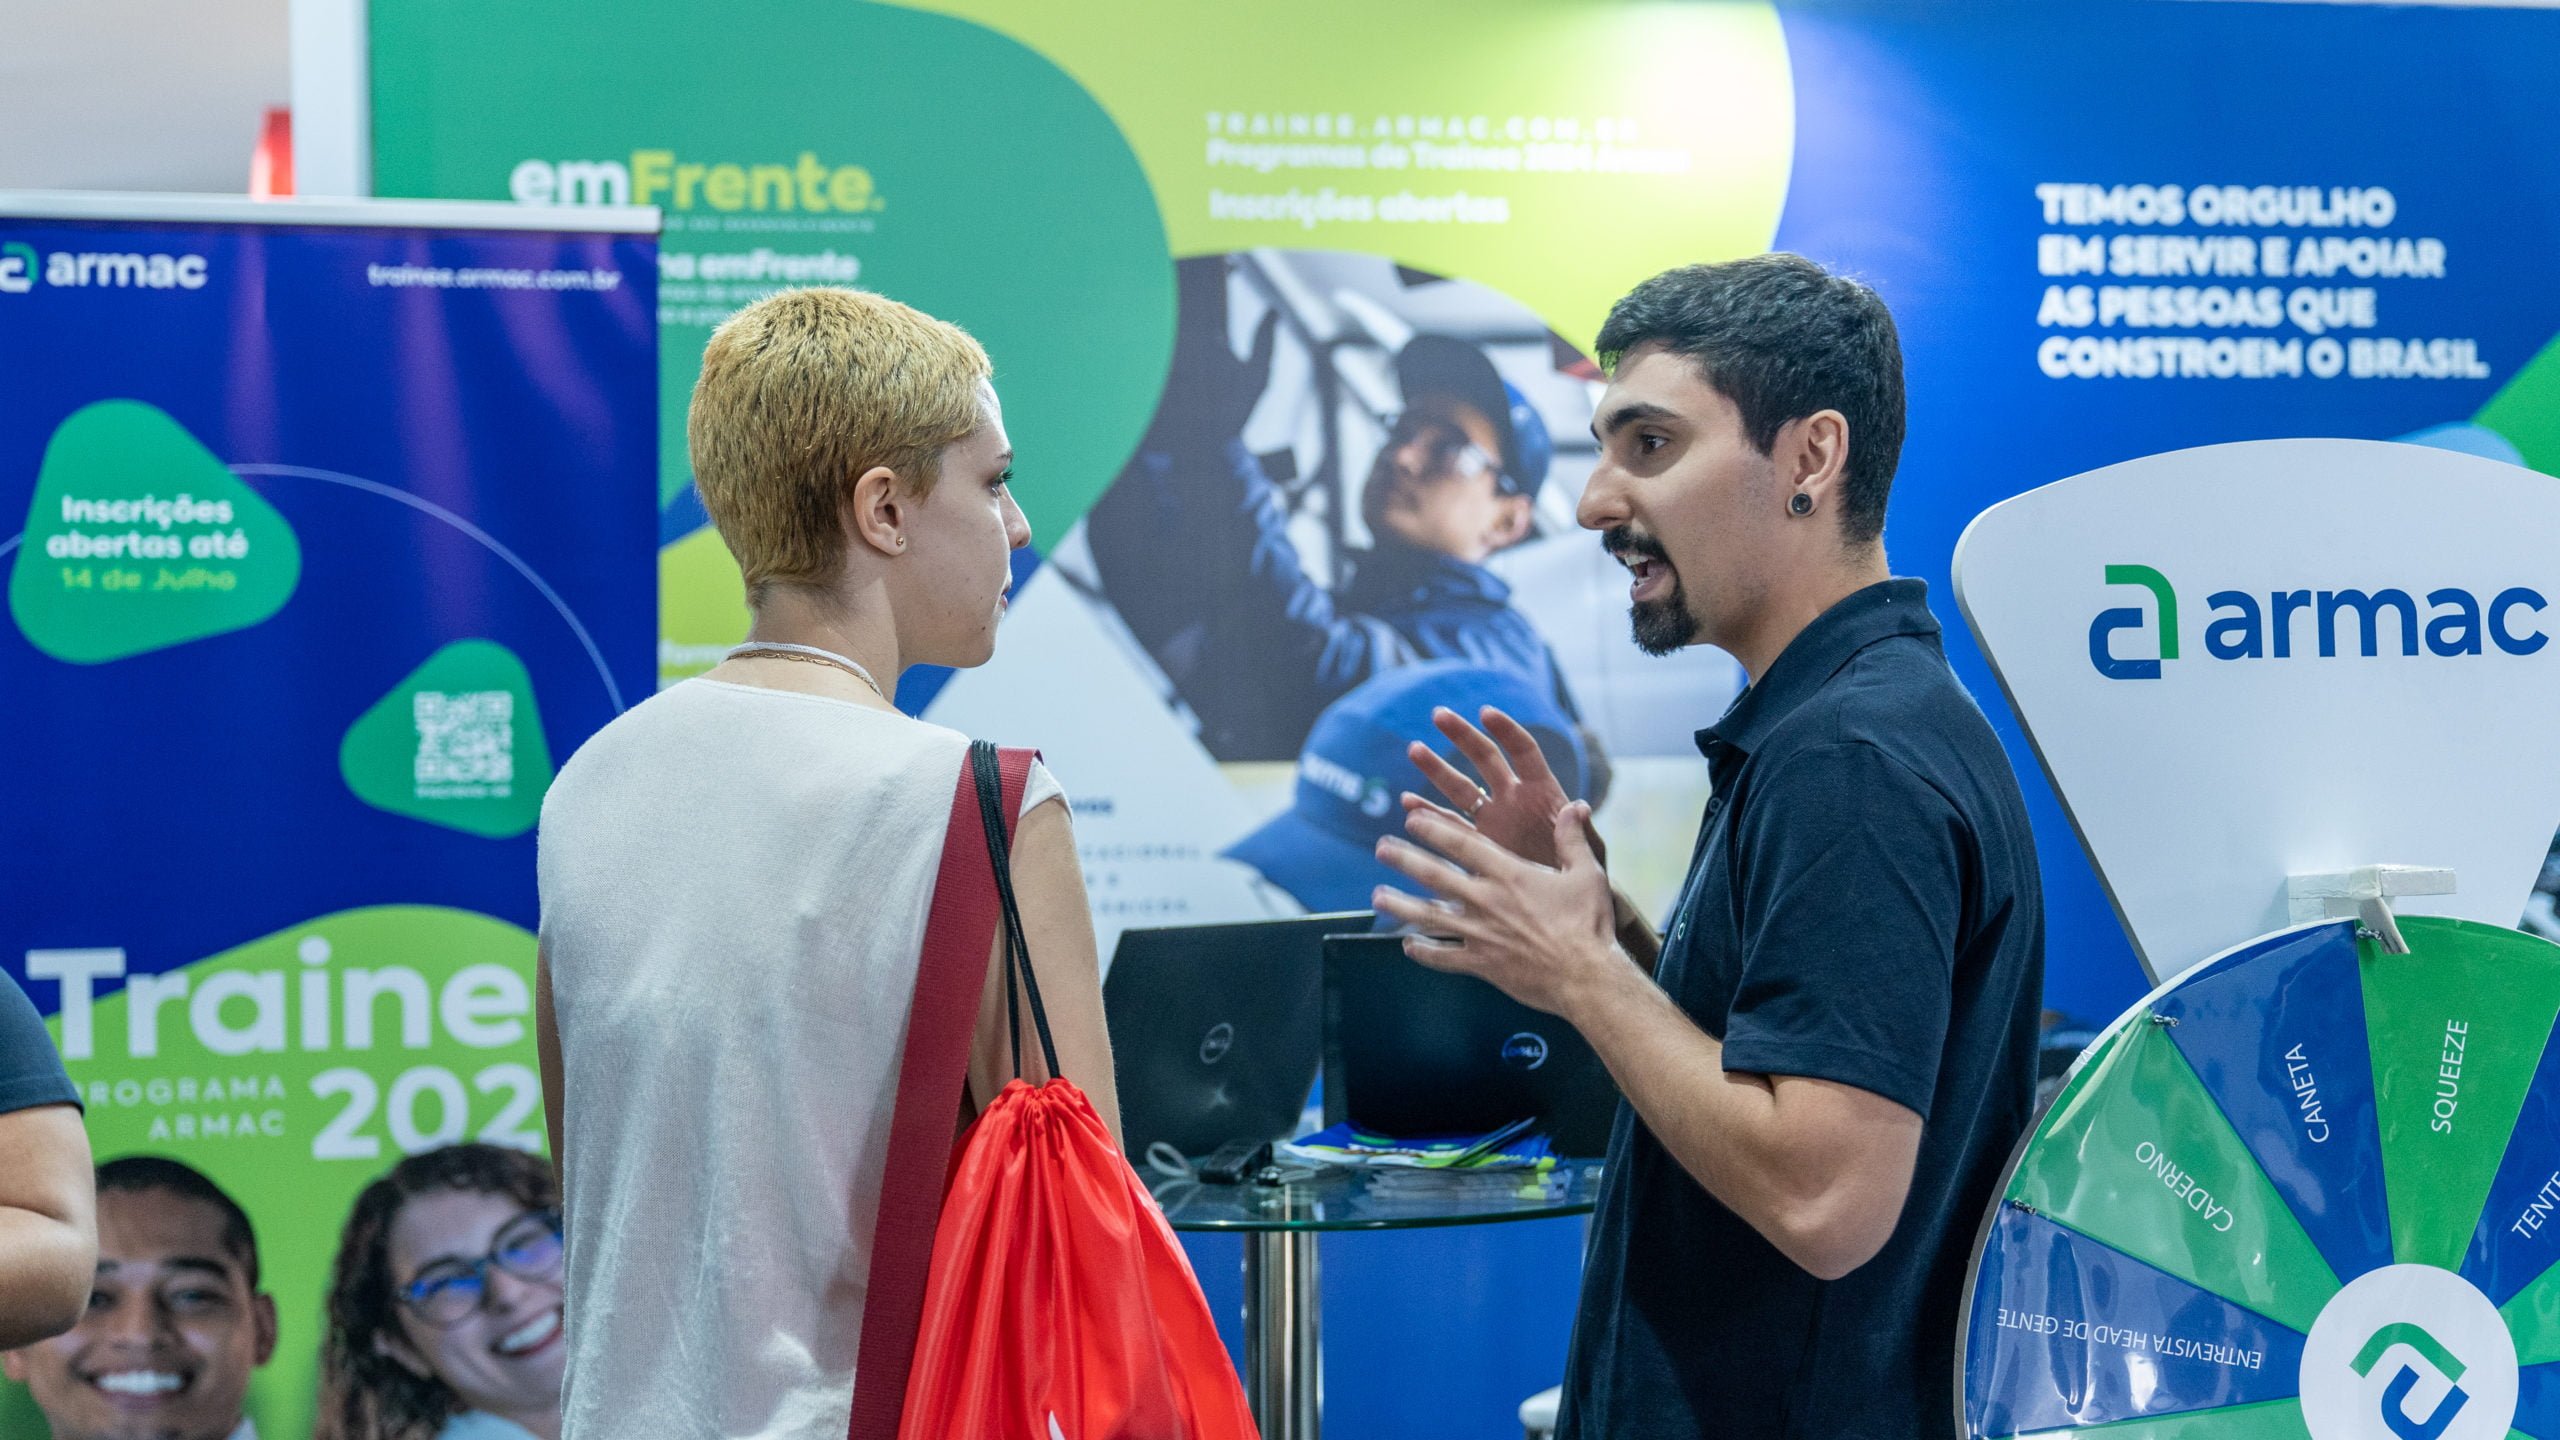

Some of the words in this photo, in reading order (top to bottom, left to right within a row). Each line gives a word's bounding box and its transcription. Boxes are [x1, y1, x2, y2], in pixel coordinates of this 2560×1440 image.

[1370, 140, 1409, 169] de
[1378, 191, 1511, 224] abertas
[2035, 183, 2186, 225] TEMOS
[2188, 184, 2396, 227] ORGULHO
[46, 252, 207, 289] armac
[2037, 234, 2105, 276] EM
[2108, 235, 2257, 277] SERVIR
[2261, 236, 2290, 276] E
[2293, 237, 2446, 278] APOIAR
[367, 263, 621, 291] trainee.armac.com.br
[2036, 285, 2096, 328] AS
[2098, 286, 2284, 328] PESSOAS
[2287, 287, 2377, 335] QUE
[2037, 335, 2303, 379] CONSTROEM
[2306, 337, 2345, 378] O
[2348, 338, 2491, 379] BRASIL
[61, 494, 234, 530] Inscrições
[46, 530, 183, 559] abertas
[188, 528, 249, 559] até
[62, 567, 92, 589] 14
[102, 567, 142, 591] de
[153, 567, 237, 591] Julho
[2205, 587, 2550, 660] armac
[26, 936, 531, 1059] Traine
[2284, 1043, 2330, 1143] CANETA
[2430, 1019, 2469, 1134] SQUEEZE
[150, 1108, 285, 1141] ARMAC
[310, 1064, 541, 1160] 202
[2135, 1141, 2234, 1232] CADERNO
[1995, 1307, 2059, 1334] GENTE
[2062, 1318, 2089, 1341] DE
[2094, 1325, 2148, 1351] HEAD
[2152, 1333, 2262, 1370] ENTREVISTA
